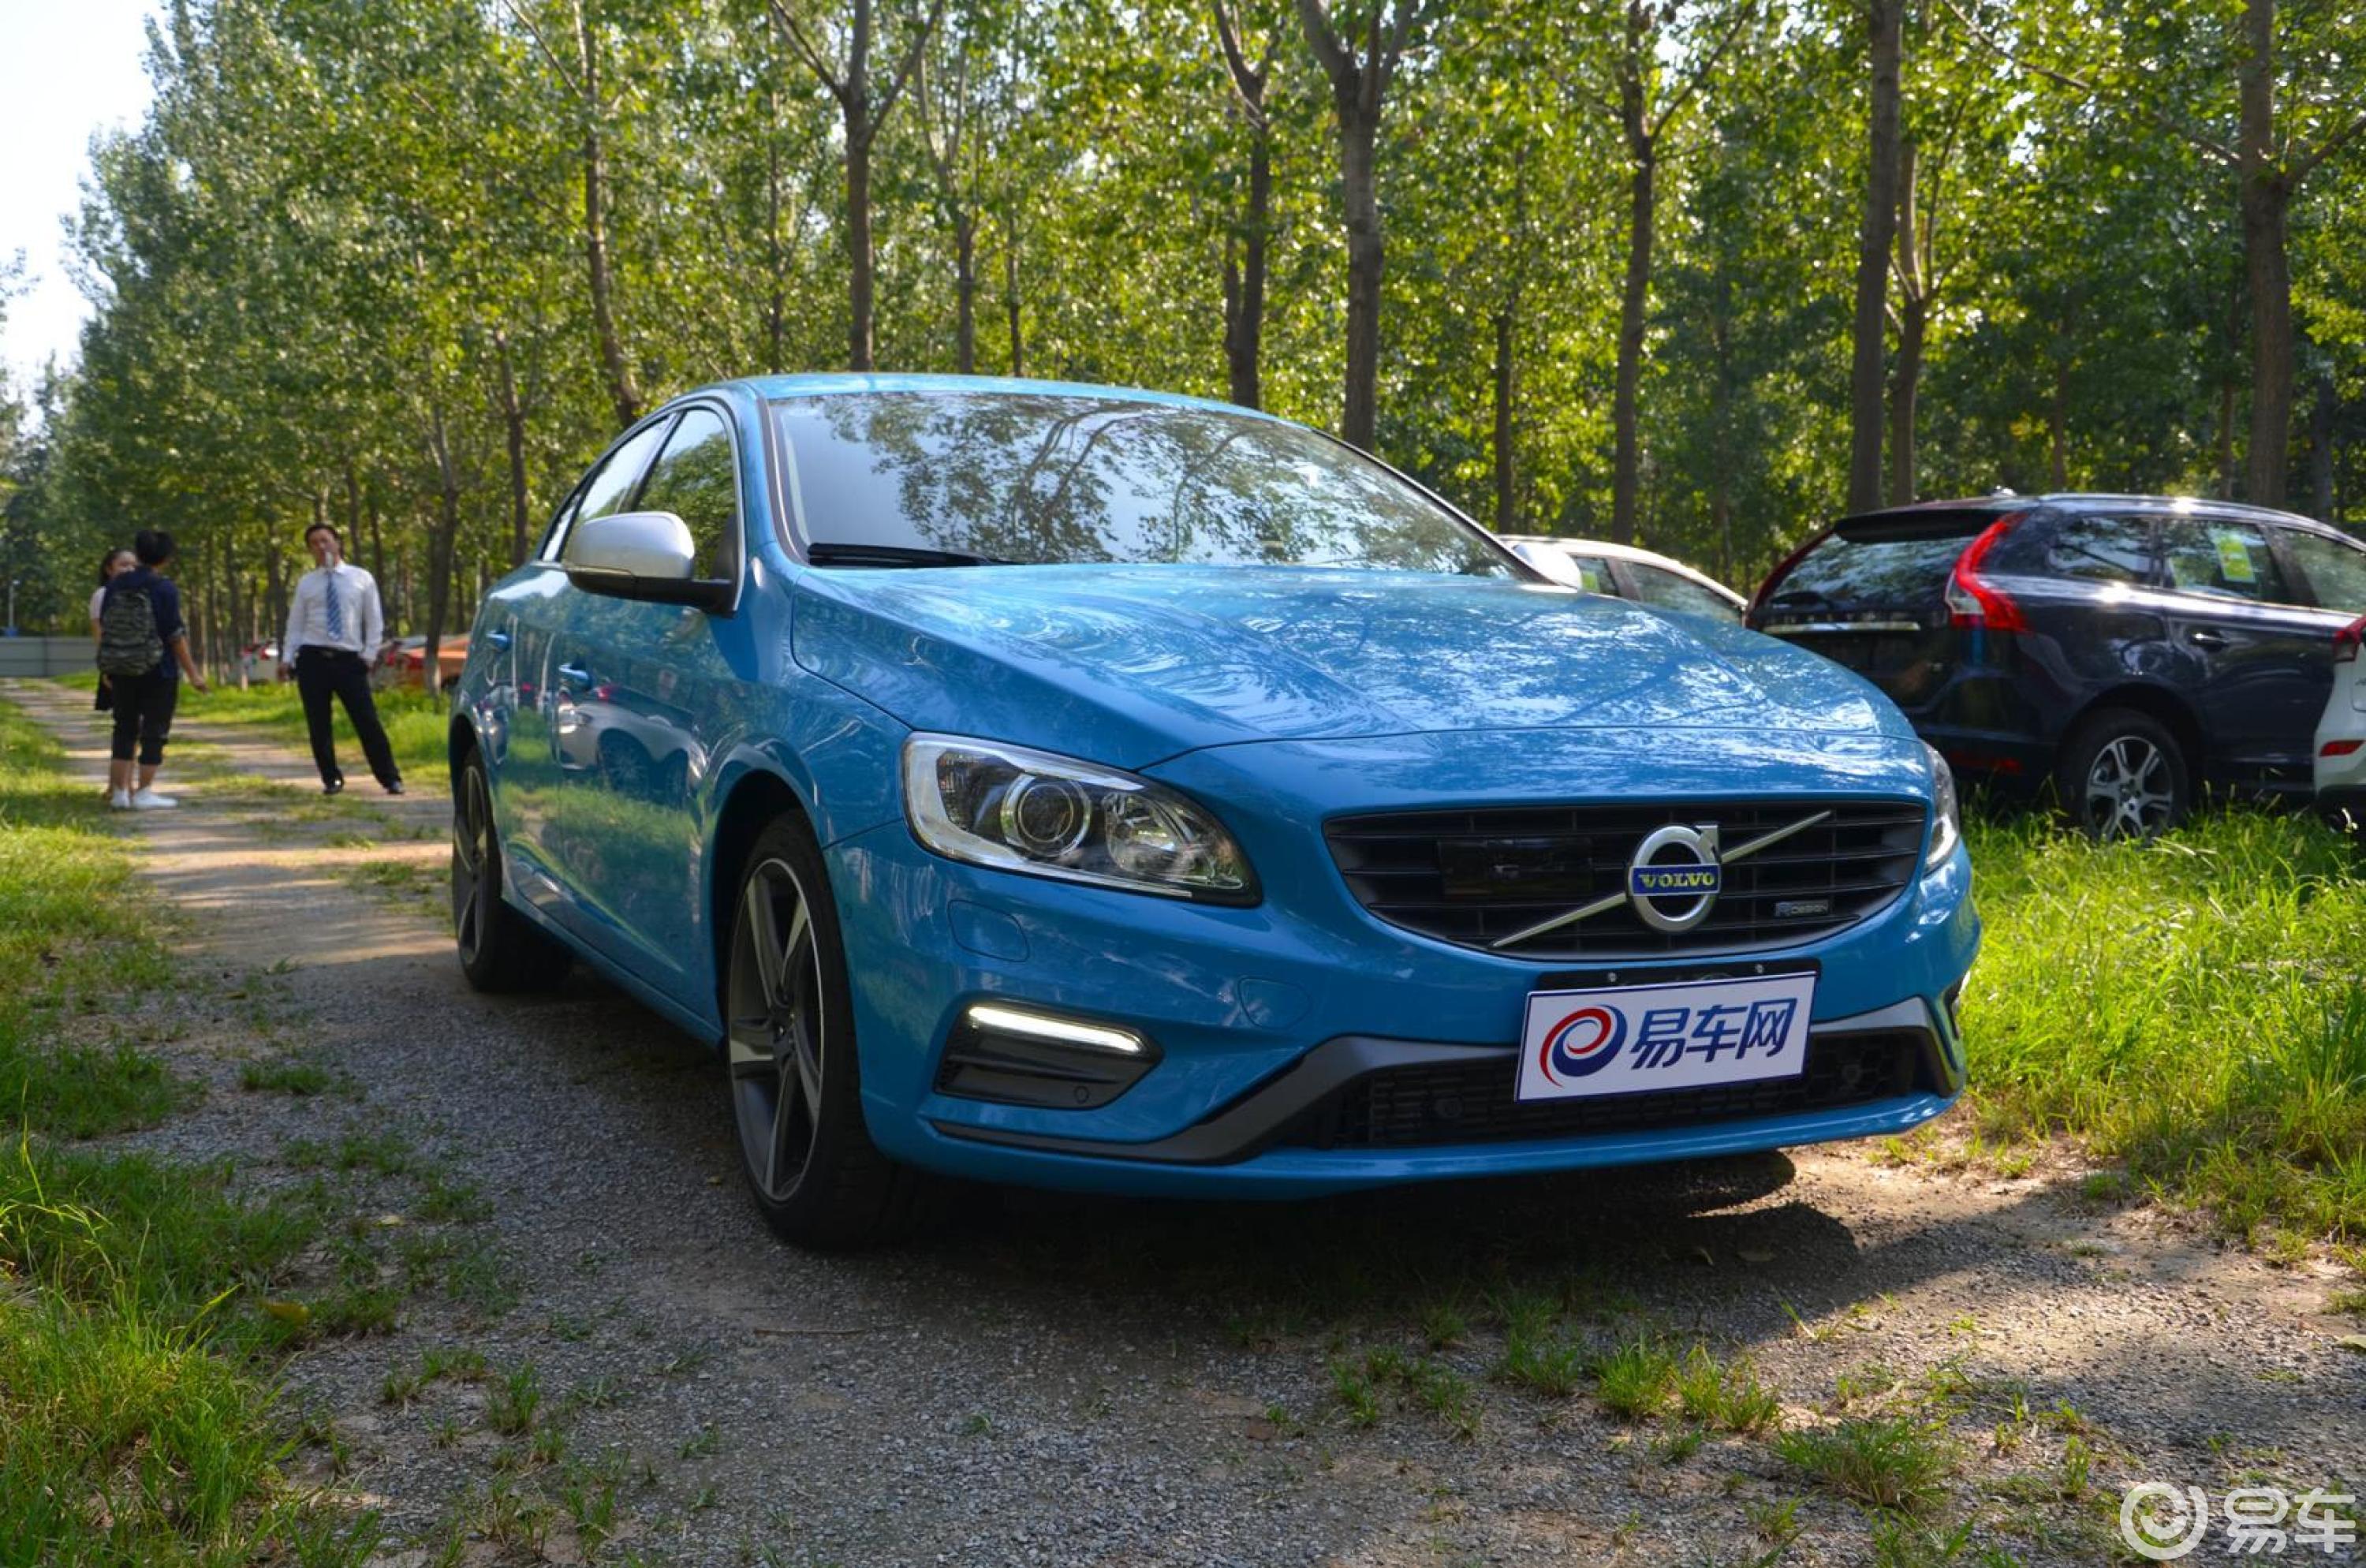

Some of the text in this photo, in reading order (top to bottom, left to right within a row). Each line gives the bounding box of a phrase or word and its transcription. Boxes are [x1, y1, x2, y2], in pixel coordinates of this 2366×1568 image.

[1638, 872, 1715, 888] VOLVO
[1629, 998, 1797, 1070] 易车网
